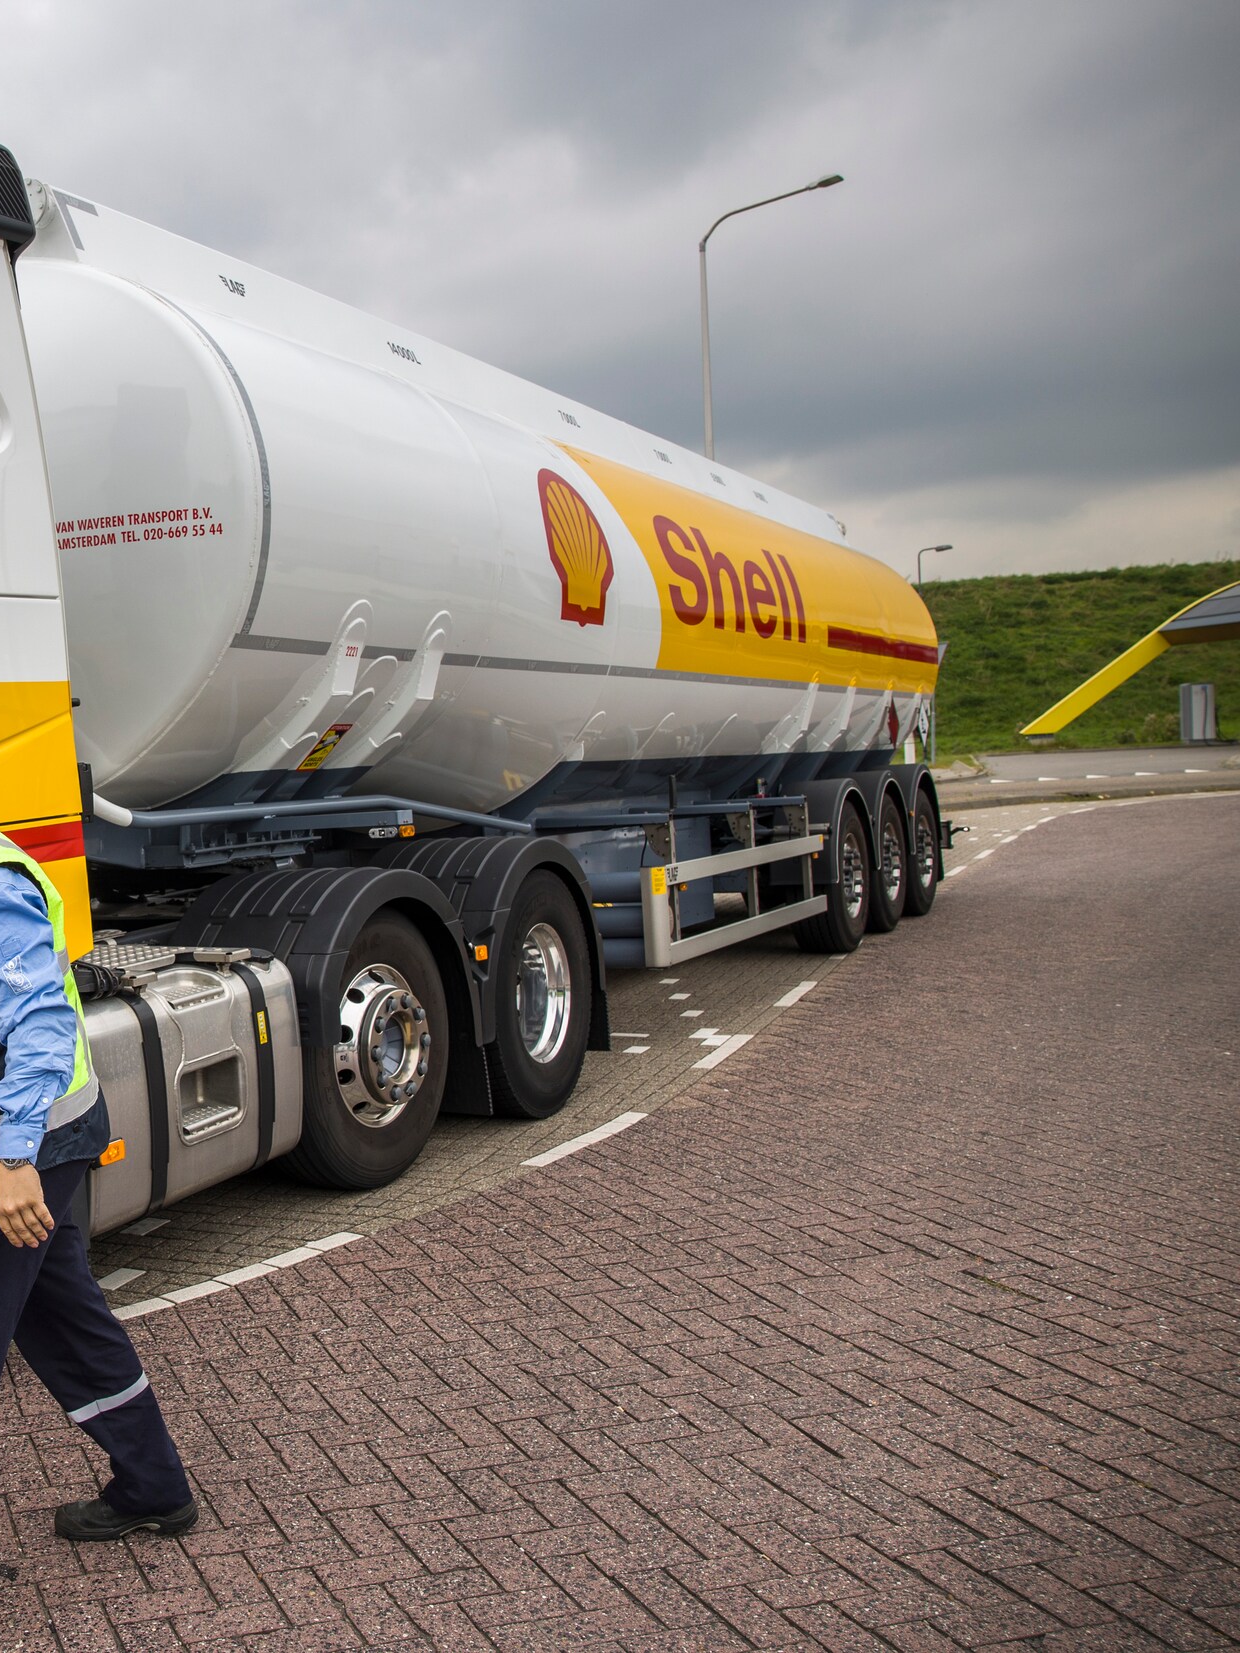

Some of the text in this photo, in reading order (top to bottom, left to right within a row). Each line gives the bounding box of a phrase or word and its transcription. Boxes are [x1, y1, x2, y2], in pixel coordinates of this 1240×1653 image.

[56, 507, 213, 534] VAN WAVEREN TRANSPORT B.V.
[121, 530, 140, 543] TEL.
[143, 525, 188, 541] 020-669
[192, 524, 206, 537] 55
[209, 522, 224, 536] 44
[653, 514, 807, 644] Shell
[345, 646, 359, 657] 2221
